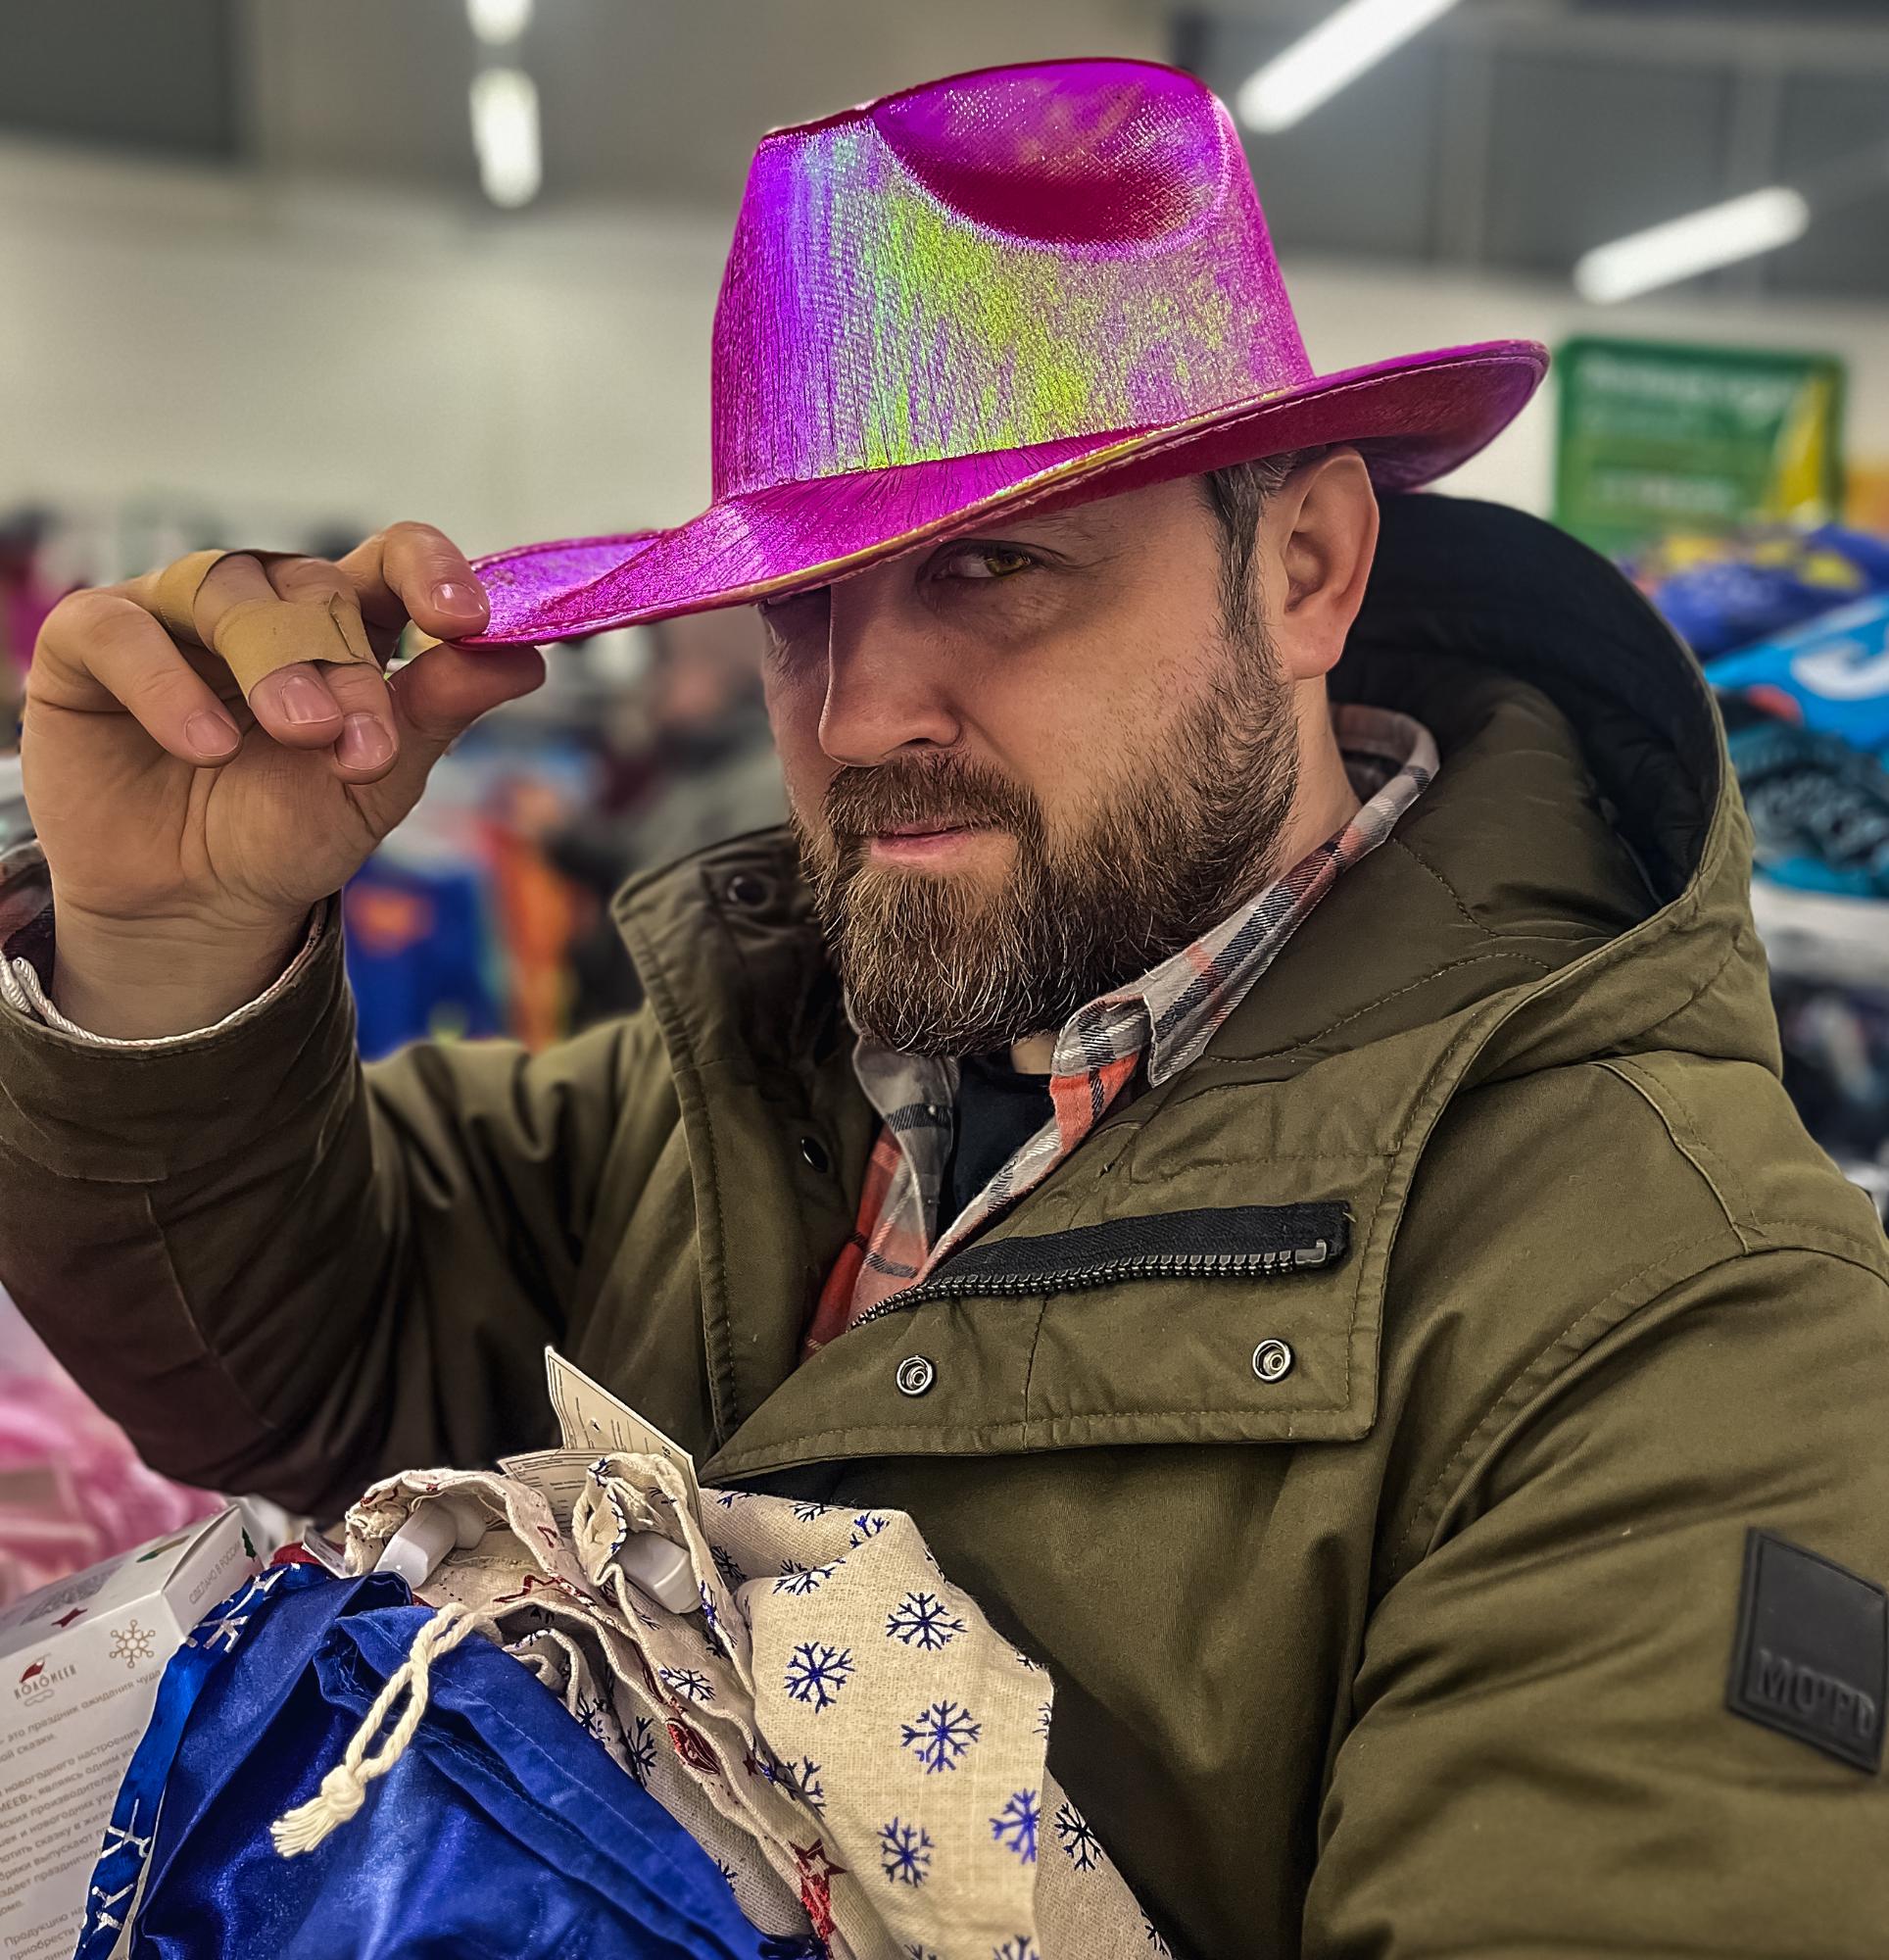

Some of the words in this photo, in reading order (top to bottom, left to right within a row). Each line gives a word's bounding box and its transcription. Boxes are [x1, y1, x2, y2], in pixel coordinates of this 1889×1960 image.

[8, 1730, 25, 1742] это
[27, 1706, 79, 1733] праздник
[81, 1681, 134, 1708] ожидания
[136, 1669, 161, 1686] чуда
[5, 1758, 75, 1794] новогоднего
[77, 1729, 140, 1761] настроения
[38, 1772, 83, 1794] являясь
[85, 1754, 120, 1774] одним
[30, 1770, 121, 1816] производителей
[29, 1799, 94, 1834] новогодних
[33, 1834, 93, 1866] выпускают
[35, 1826, 72, 1848] сказку
[4, 1913, 69, 1947] Продукцию
